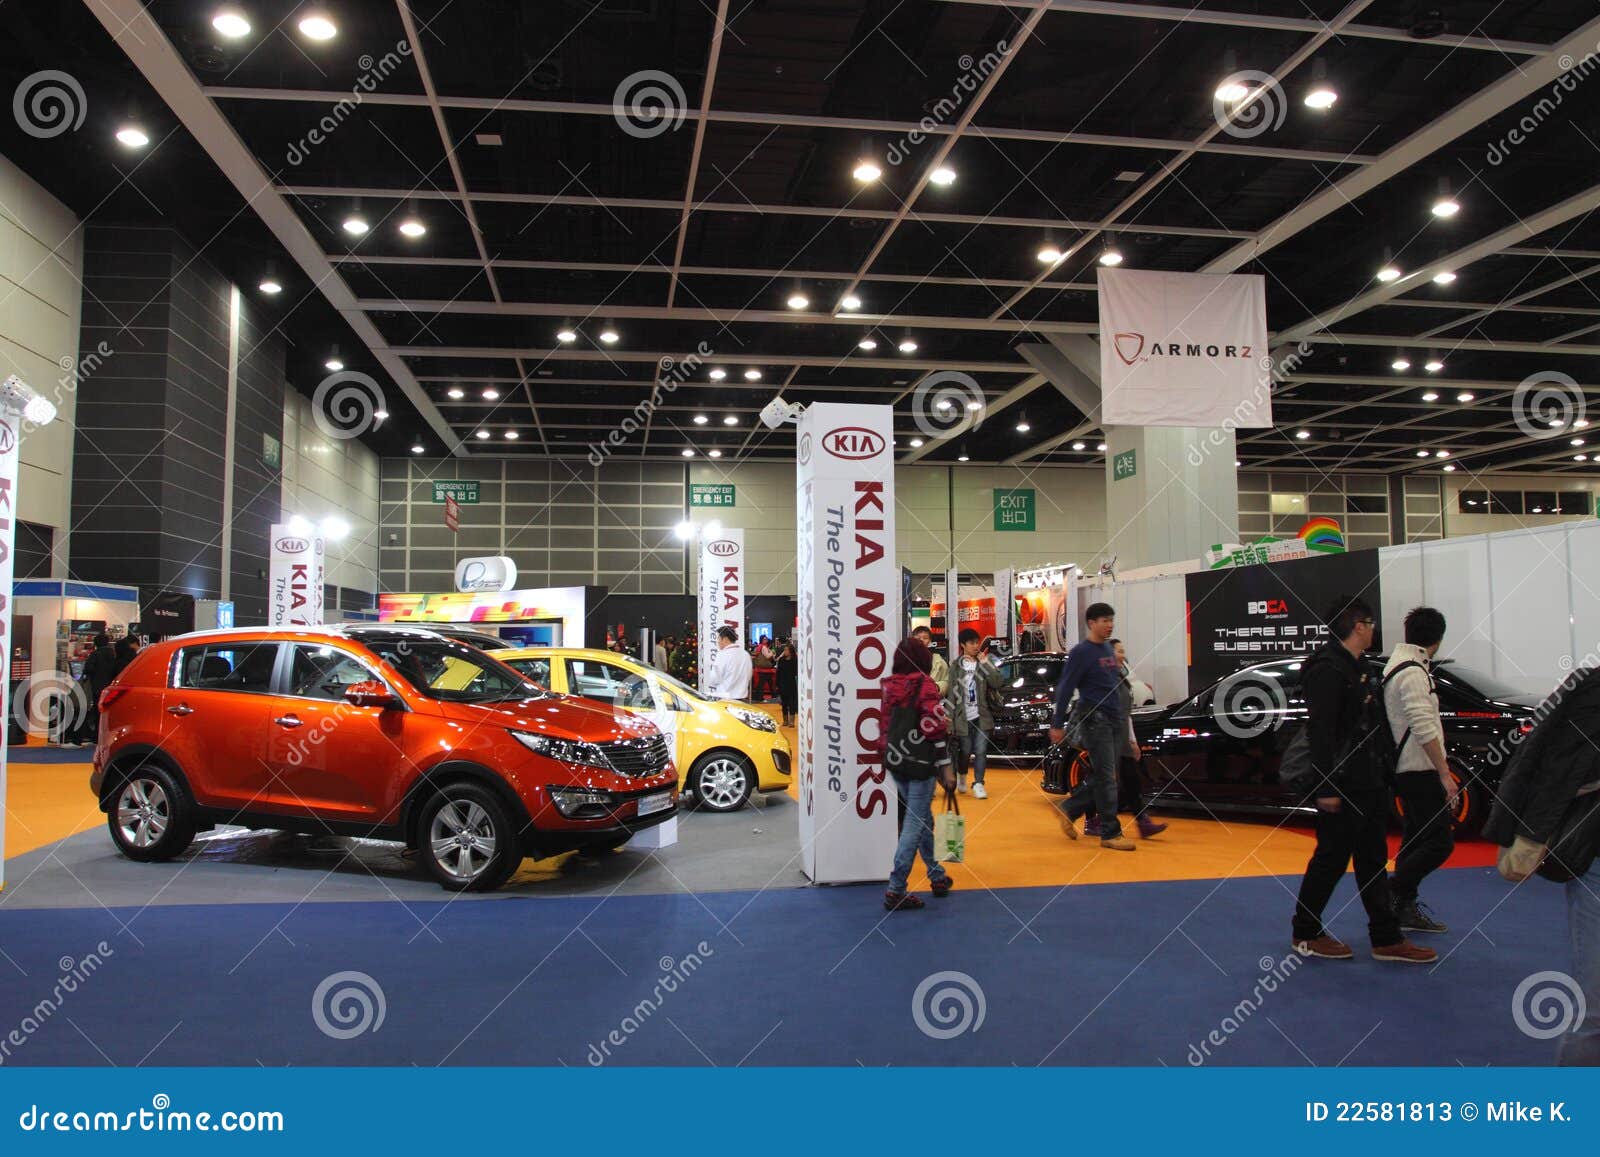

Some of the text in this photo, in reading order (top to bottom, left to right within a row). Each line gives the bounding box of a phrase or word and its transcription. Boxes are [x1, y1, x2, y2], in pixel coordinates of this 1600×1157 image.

[1152, 343, 1252, 358] ARMORZ
[834, 434, 876, 453] KIA
[1000, 495, 1028, 508] EXIT
[854, 480, 884, 570] KIA
[1002, 510, 1026, 523] 出口
[826, 505, 844, 552] The
[281, 540, 304, 550] KIA
[713, 542, 735, 553] KIA
[276, 577, 286, 601] The
[290, 564, 307, 610] KIA
[709, 579, 719, 602] The
[723, 566, 739, 611] KIA
[826, 558, 844, 643] Power
[709, 604, 719, 646] Power
[1215, 625, 1276, 637] THERE
[1281, 625, 1298, 636] IS
[826, 648, 843, 675] to
